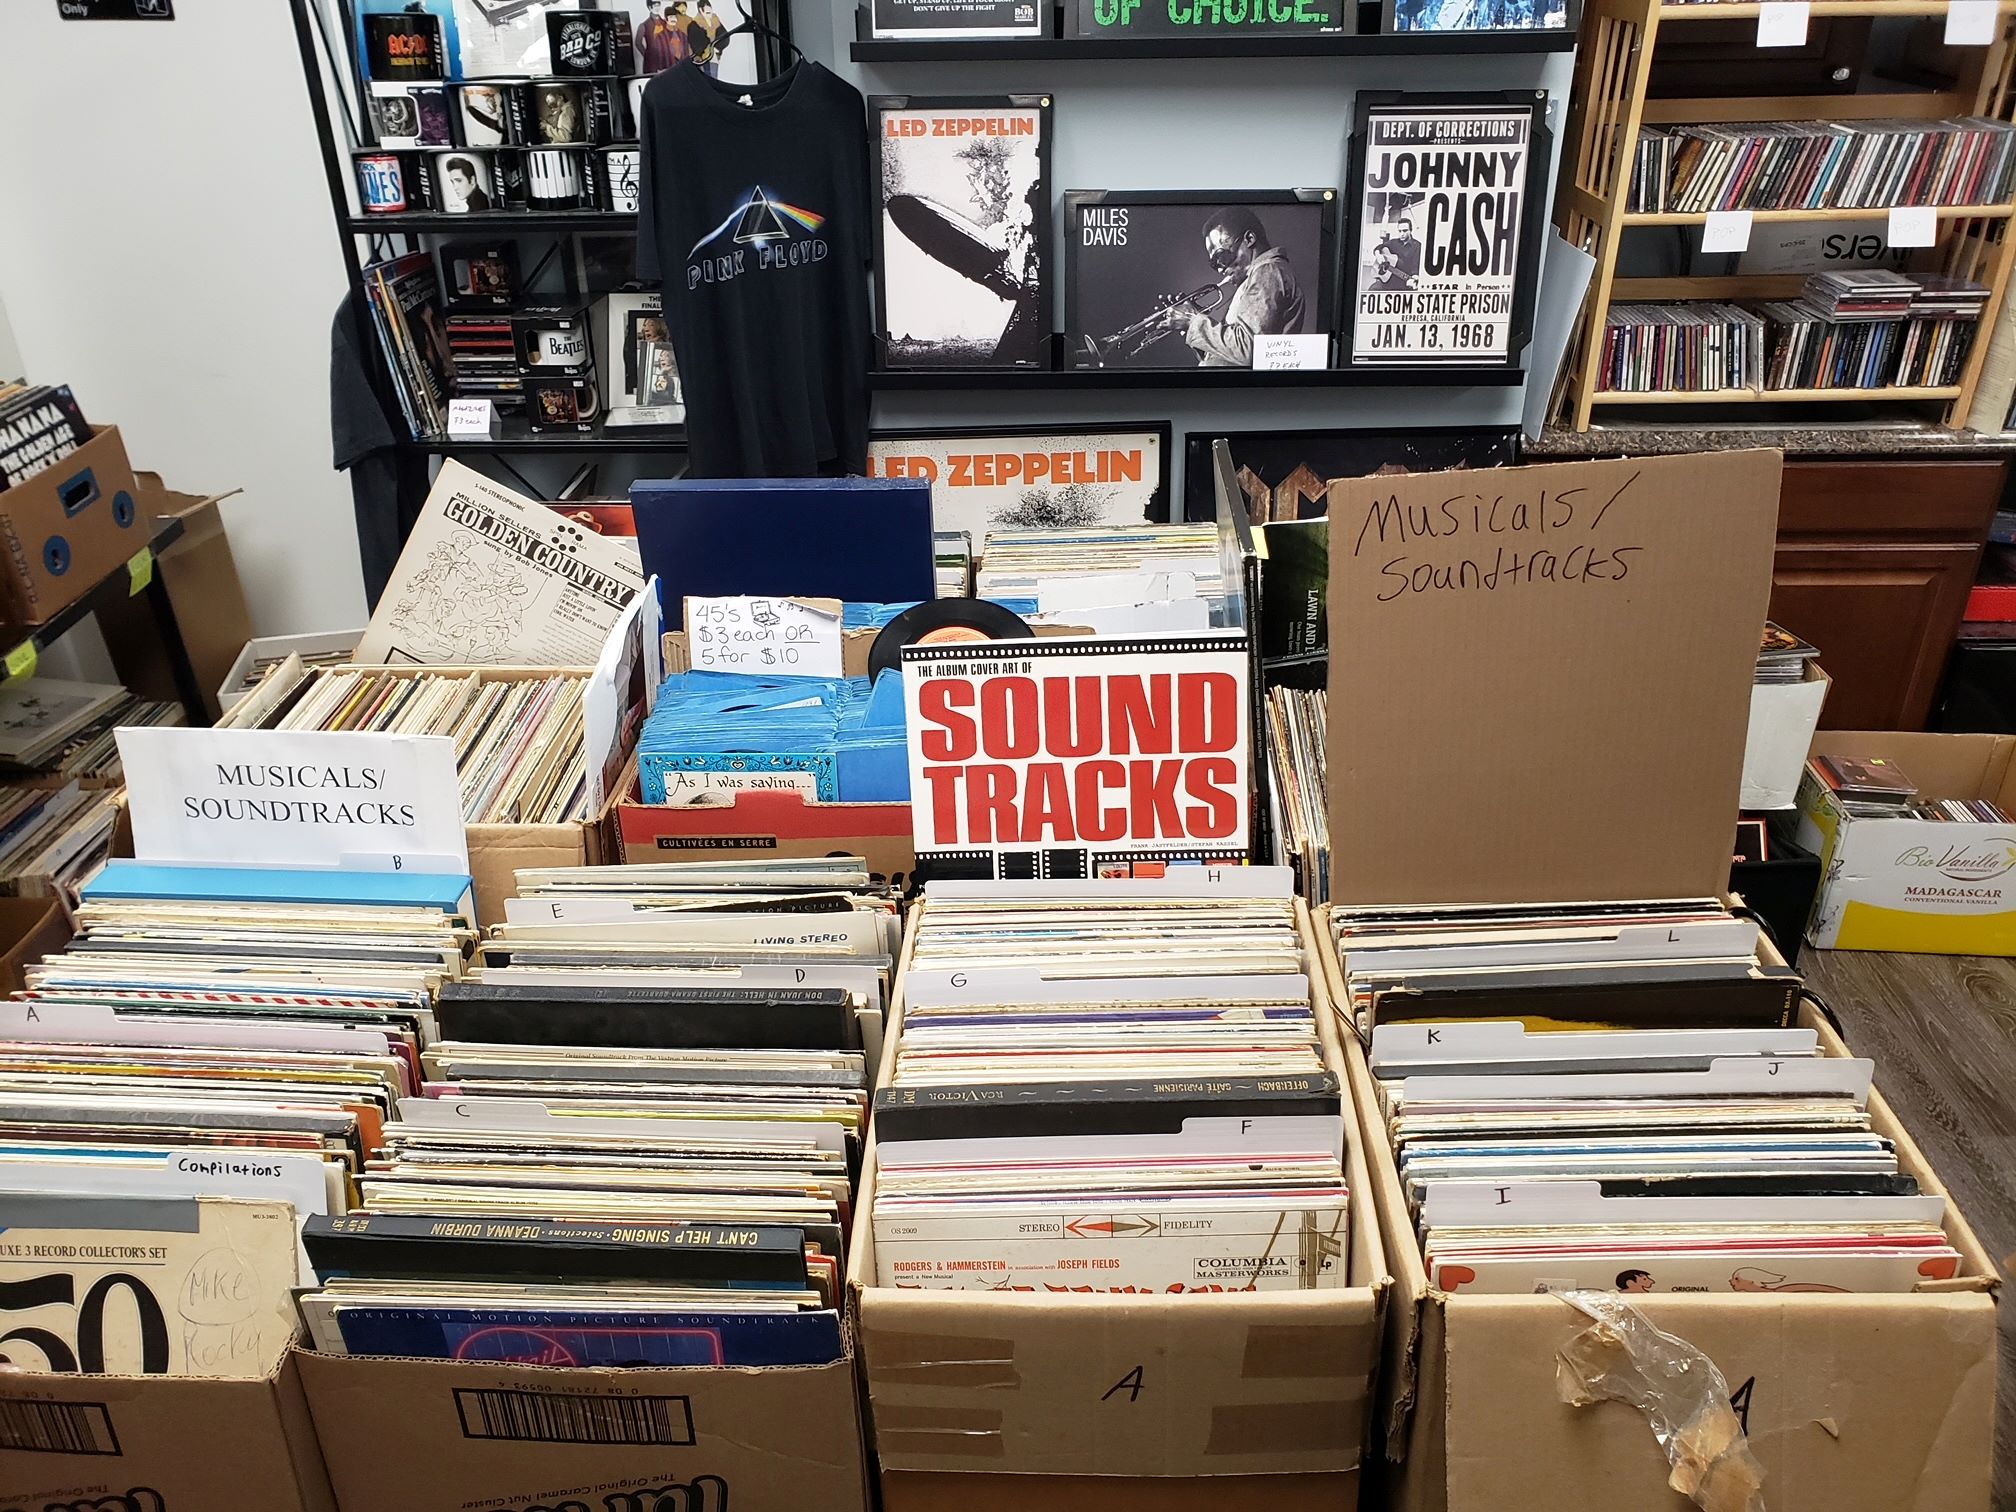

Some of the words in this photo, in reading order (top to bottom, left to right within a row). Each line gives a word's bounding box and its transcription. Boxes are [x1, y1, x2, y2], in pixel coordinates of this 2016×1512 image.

[62, 3, 88, 16] Only
[1014, 7, 1033, 15] BOB
[559, 38, 584, 60] BAD
[886, 119, 927, 138] LED
[931, 118, 1034, 137] ZEPPELIN
[1383, 121, 1414, 138] DEPT.
[1418, 121, 1432, 138] OF
[1436, 120, 1515, 138] CORRECTIONS
[1368, 151, 1522, 188] JOHNNY
[1082, 208, 1129, 227] MILES
[1082, 227, 1128, 247] DAVIS
[1424, 191, 1518, 276] CASH
[687, 250, 744, 290] PINK
[759, 239, 828, 269] FLOYD
[1360, 294, 1412, 314] FOLSOM
[1416, 294, 1456, 314] STATE
[1460, 294, 1510, 314] PRISON
[1267, 340, 1295, 349] VINYL
[1371, 324, 1411, 348] JAN.
[1419, 324, 1444, 351] 13,
[1451, 323, 1494, 348] 1968
[549, 337, 584, 357] BEATLES
[946, 449, 1143, 487] ZEPPELIN
[487, 489, 526, 513] STEREOPHONIC
[455, 491, 496, 516] MILLION
[498, 514, 542, 539] SELLERS
[446, 499, 537, 560] GOLDEN
[533, 545, 631, 606] COUNTRY
[483, 540, 502, 554] sung
[503, 550, 513, 559] by
[515, 555, 530, 567] Bob
[531, 563, 553, 578] Jones
[696, 603, 741, 623] 45's
[1306, 590, 1319, 620] LAWN
[699, 625, 729, 644] $3
[734, 626, 775, 642] each
[785, 624, 813, 641] OR
[1305, 623, 1317, 645] AND
[701, 647, 715, 665] 5
[718, 645, 750, 664] for
[760, 646, 799, 665] $10
[917, 664, 934, 677] THE
[935, 664, 968, 677] ALBUM
[970, 663, 998, 676] COVER
[1001, 662, 1019, 674] ART
[1021, 662, 1032, 674] OF
[918, 673, 1238, 762] SOUND
[216, 763, 386, 790] MUSICALS/
[704, 773, 711, 788] I
[716, 775, 744, 788] was
[922, 757, 1238, 845] TRACKS
[183, 796, 415, 827] SOUNDTRACKS
[740, 839, 771, 847] SERRE
[392, 854, 403, 871] B
[1895, 846, 1935, 867] Bio
[1935, 844, 2000, 868] Vanilla
[1208, 869, 1221, 882] H
[1904, 886, 2002, 898] MADAGASCAR
[791, 902, 840, 912] PICTURE
[1904, 897, 1963, 905] CONVENTIONAL
[551, 903, 565, 919] E
[800, 933, 848, 944] STEREO
[1668, 930, 1680, 942] L
[795, 969, 806, 983] D
[950, 972, 967, 988] G
[769, 991, 778, 999] IN
[780, 991, 803, 999] JUAN
[26, 1006, 41, 1023] A
[1427, 1028, 1442, 1044] K
[1767, 1061, 1784, 1076] J
[1153, 1083, 1204, 1095] PARISIENNE
[1257, 1079, 1309, 1091] OFFENBACH
[456, 1104, 470, 1117] C
[1240, 1120, 1253, 1135] F
[178, 1157, 283, 1178] Compilations
[1494, 1187, 1511, 1205] I
[431, 1222, 482, 1238] DURBIN
[486, 1224, 540, 1239] DEANNA
[1018, 1222, 1061, 1233] STEREO
[1163, 1219, 1214, 1230] FIDELITY
[611, 1228, 670, 1244] SINGING
[675, 1230, 712, 1245] HELP
[716, 1231, 758, 1246] CAN'T
[25, 1246, 31, 1257] 3
[34, 1246, 77, 1258] RECORD
[79, 1247, 146, 1258] COLLECTOR'S
[149, 1247, 167, 1259] SET
[894, 1260, 932, 1271] RODGERS
[936, 1261, 943, 1270] &
[946, 1260, 1006, 1271] HAMMERSTEIN
[1057, 1259, 1088, 1270] JOSEPH
[1091, 1258, 1120, 1269] FIELDS
[1198, 1257, 1288, 1268] COLUMBIA
[1196, 1269, 1290, 1278] MASTERWORKS
[0, 1271, 169, 1374] 50
[349, 1311, 453, 1323] ORIGINAL
[472, 1313, 553, 1324] MOTION
[570, 1315, 660, 1325] PICTURE
[678, 1315, 822, 1326] SOUNDTRACK
[1101, 1365, 1145, 1402] A
[1729, 1375, 1755, 1437] A
[593, 1476, 648, 1492] Original
[652, 1473, 675, 1484] The
[508, 1494, 532, 1504] Nut
[536, 1485, 591, 1500] Caramel
[461, 1498, 505, 1510] Cluster
